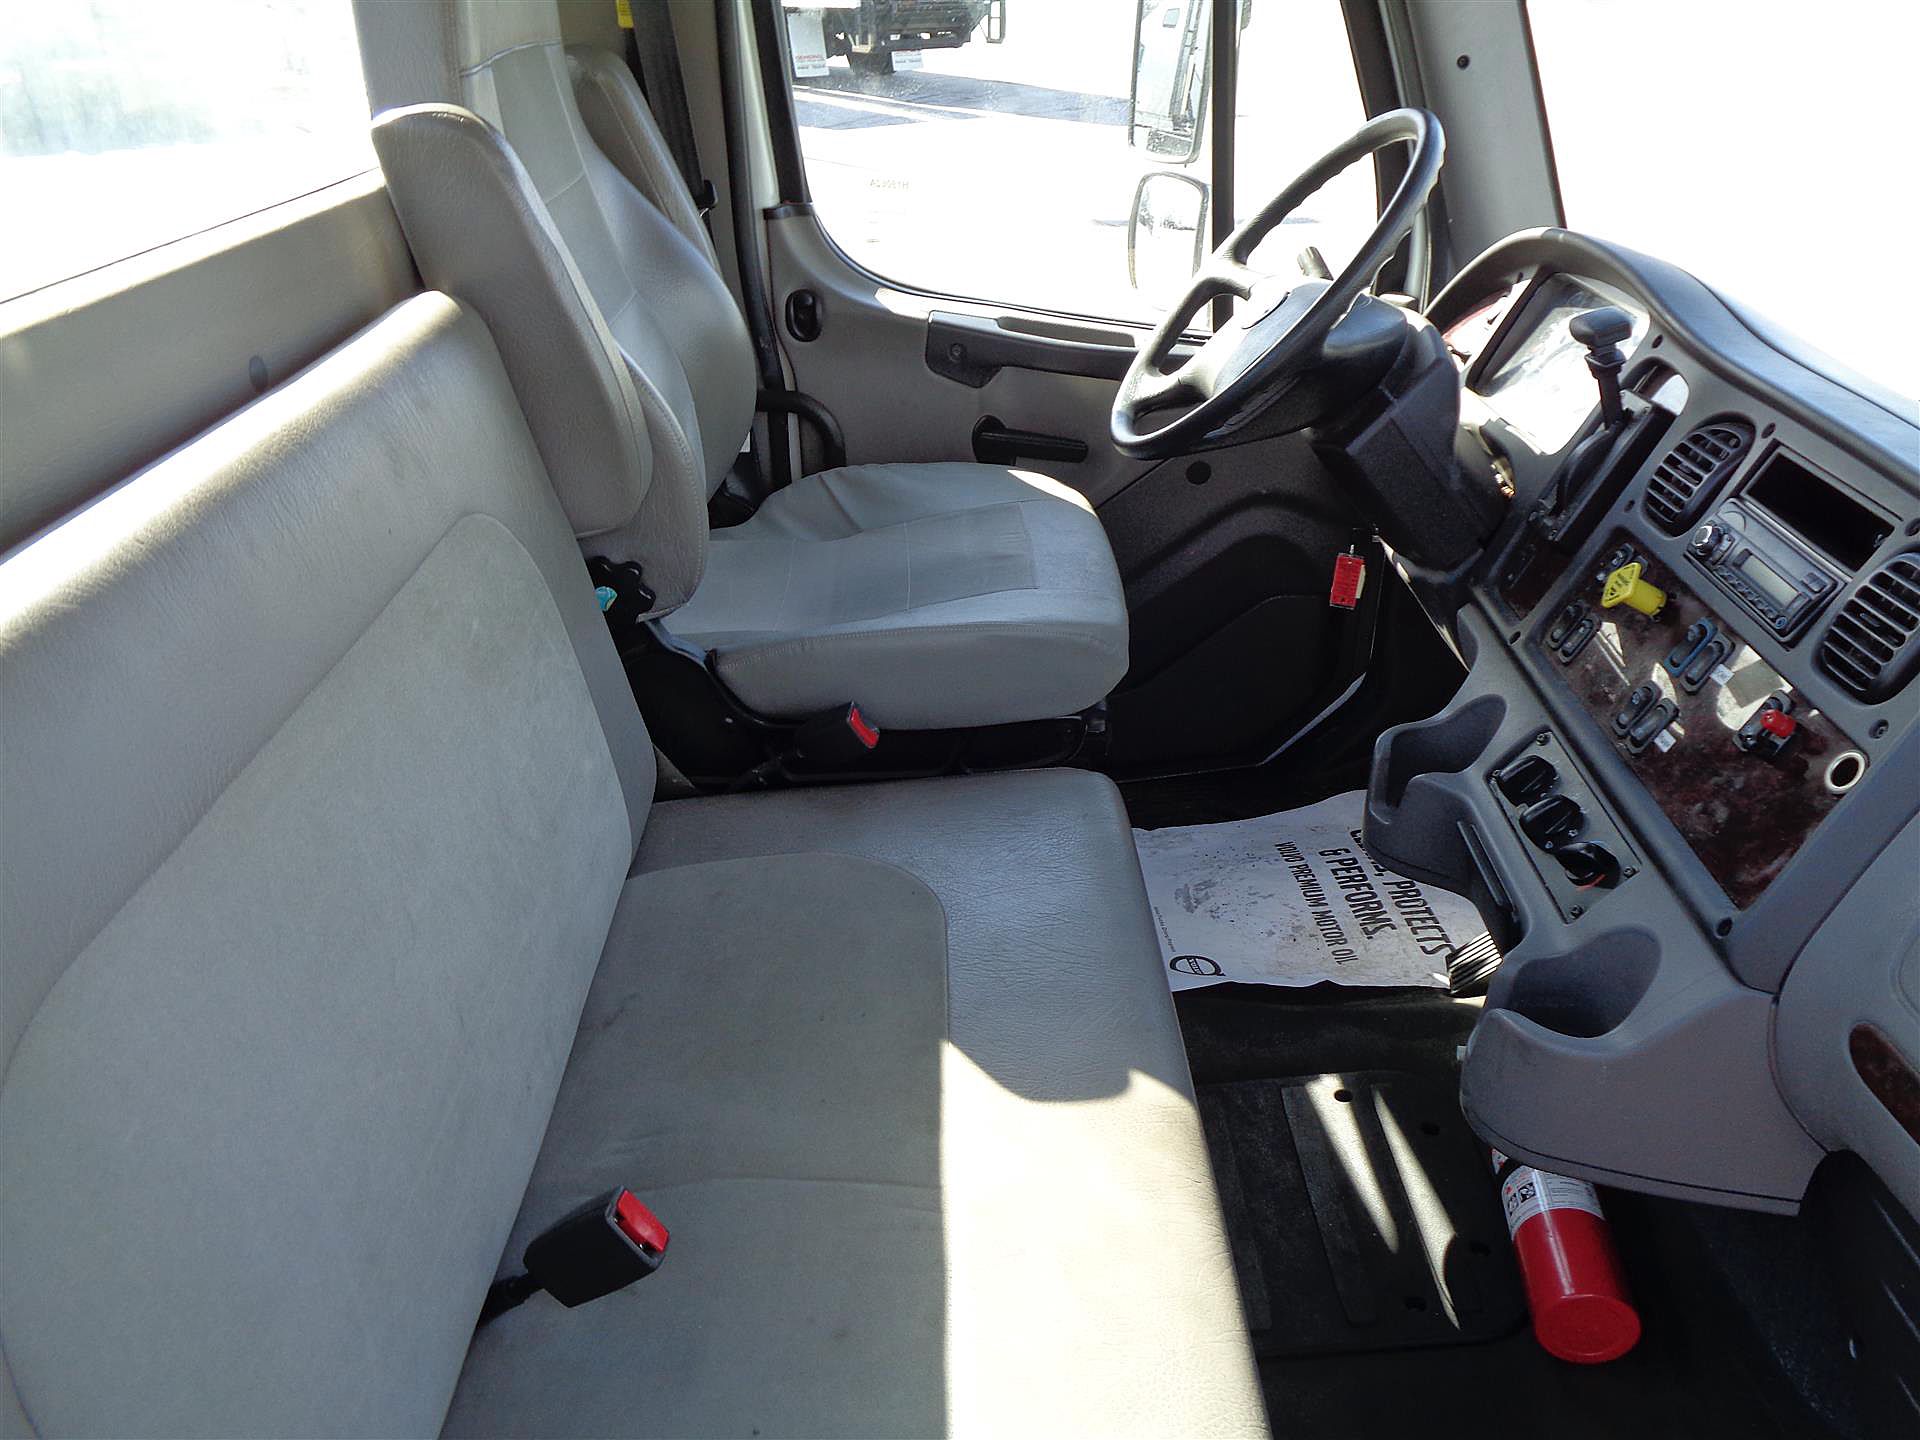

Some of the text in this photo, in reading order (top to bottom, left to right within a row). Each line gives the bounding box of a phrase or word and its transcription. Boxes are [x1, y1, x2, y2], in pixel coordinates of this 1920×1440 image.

[1275, 841, 1359, 965] VOLVO PREMIUM MOTOR OIL
[1326, 857, 1397, 939] PERFORMS.
[1382, 881, 1458, 954] PROTECTS
